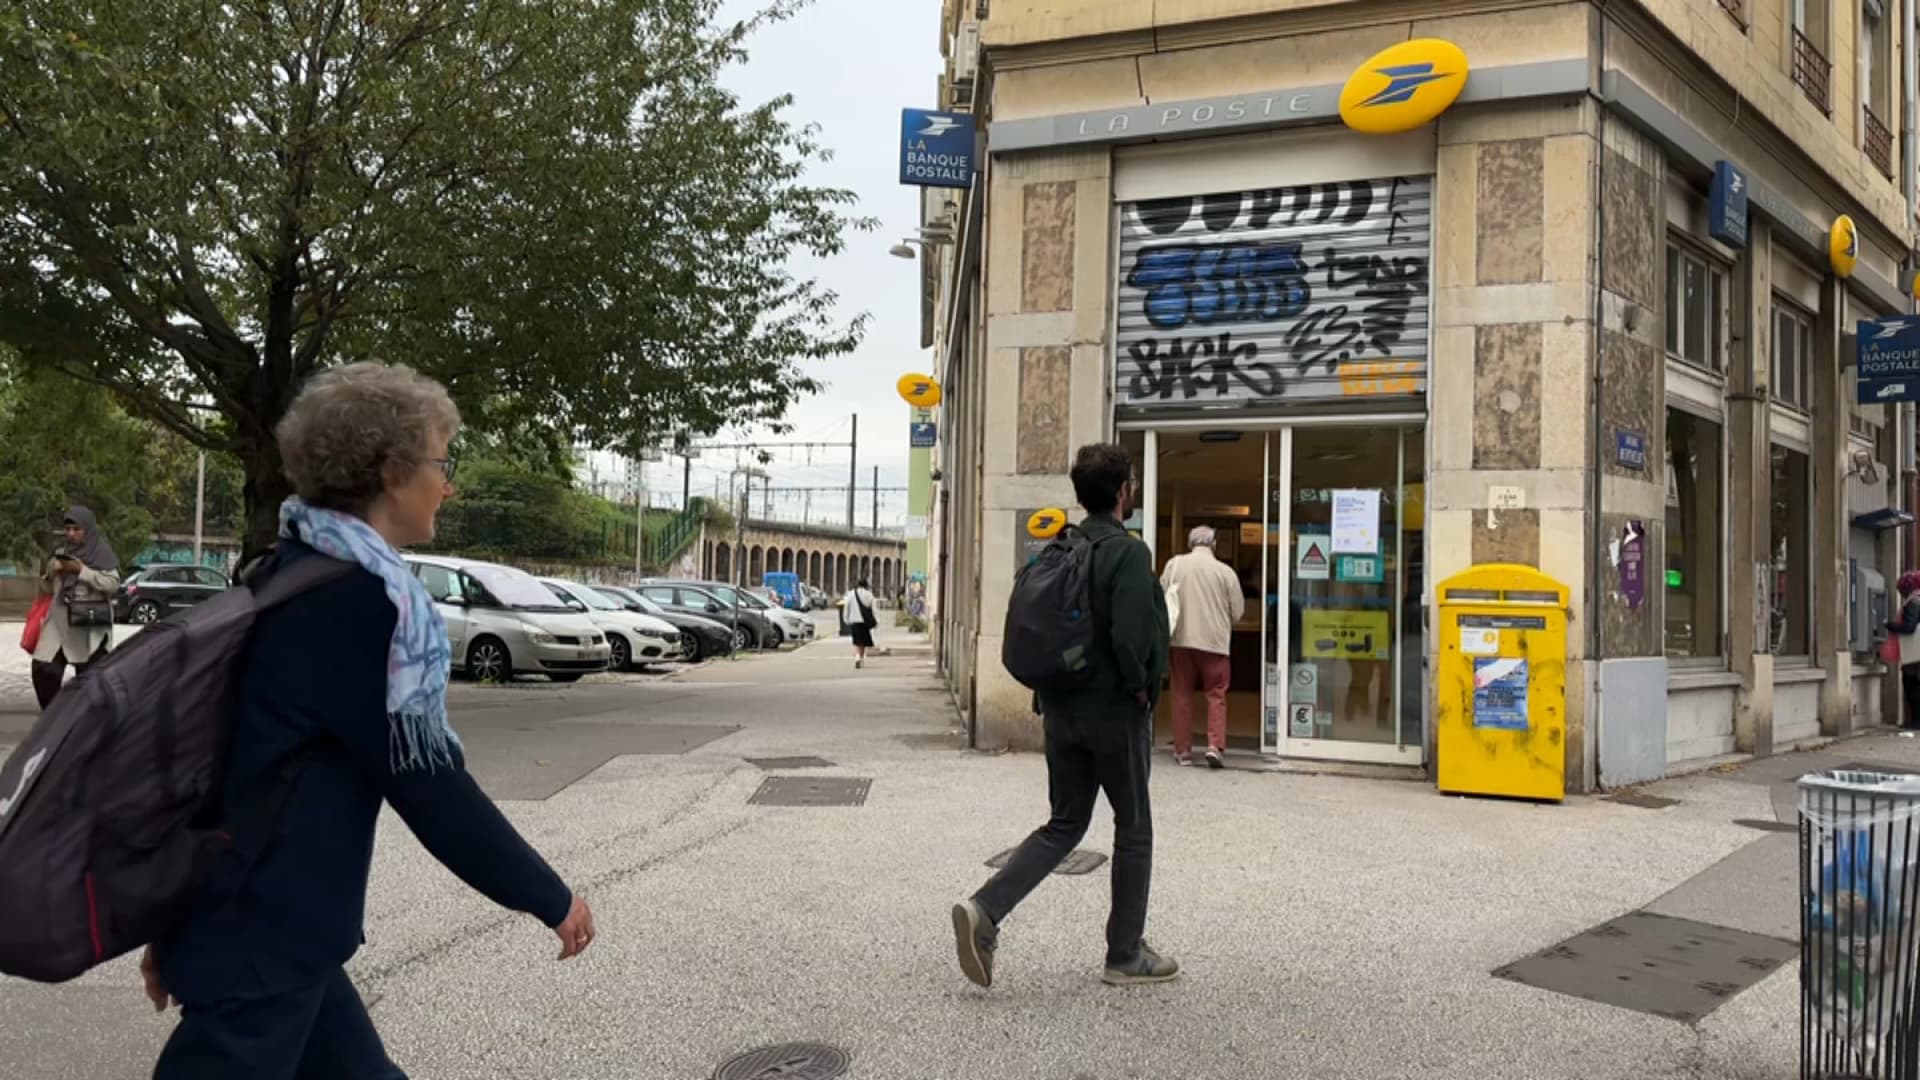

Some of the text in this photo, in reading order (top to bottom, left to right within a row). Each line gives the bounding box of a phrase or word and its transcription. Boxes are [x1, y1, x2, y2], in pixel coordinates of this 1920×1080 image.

[1079, 94, 1312, 136] LA POSTE
[907, 139, 927, 151] LA
[907, 152, 968, 168] BANQUE
[906, 164, 968, 181] POSTALE
[1862, 348, 1920, 363] BANQUE
[1862, 359, 1920, 373] POSTALE
